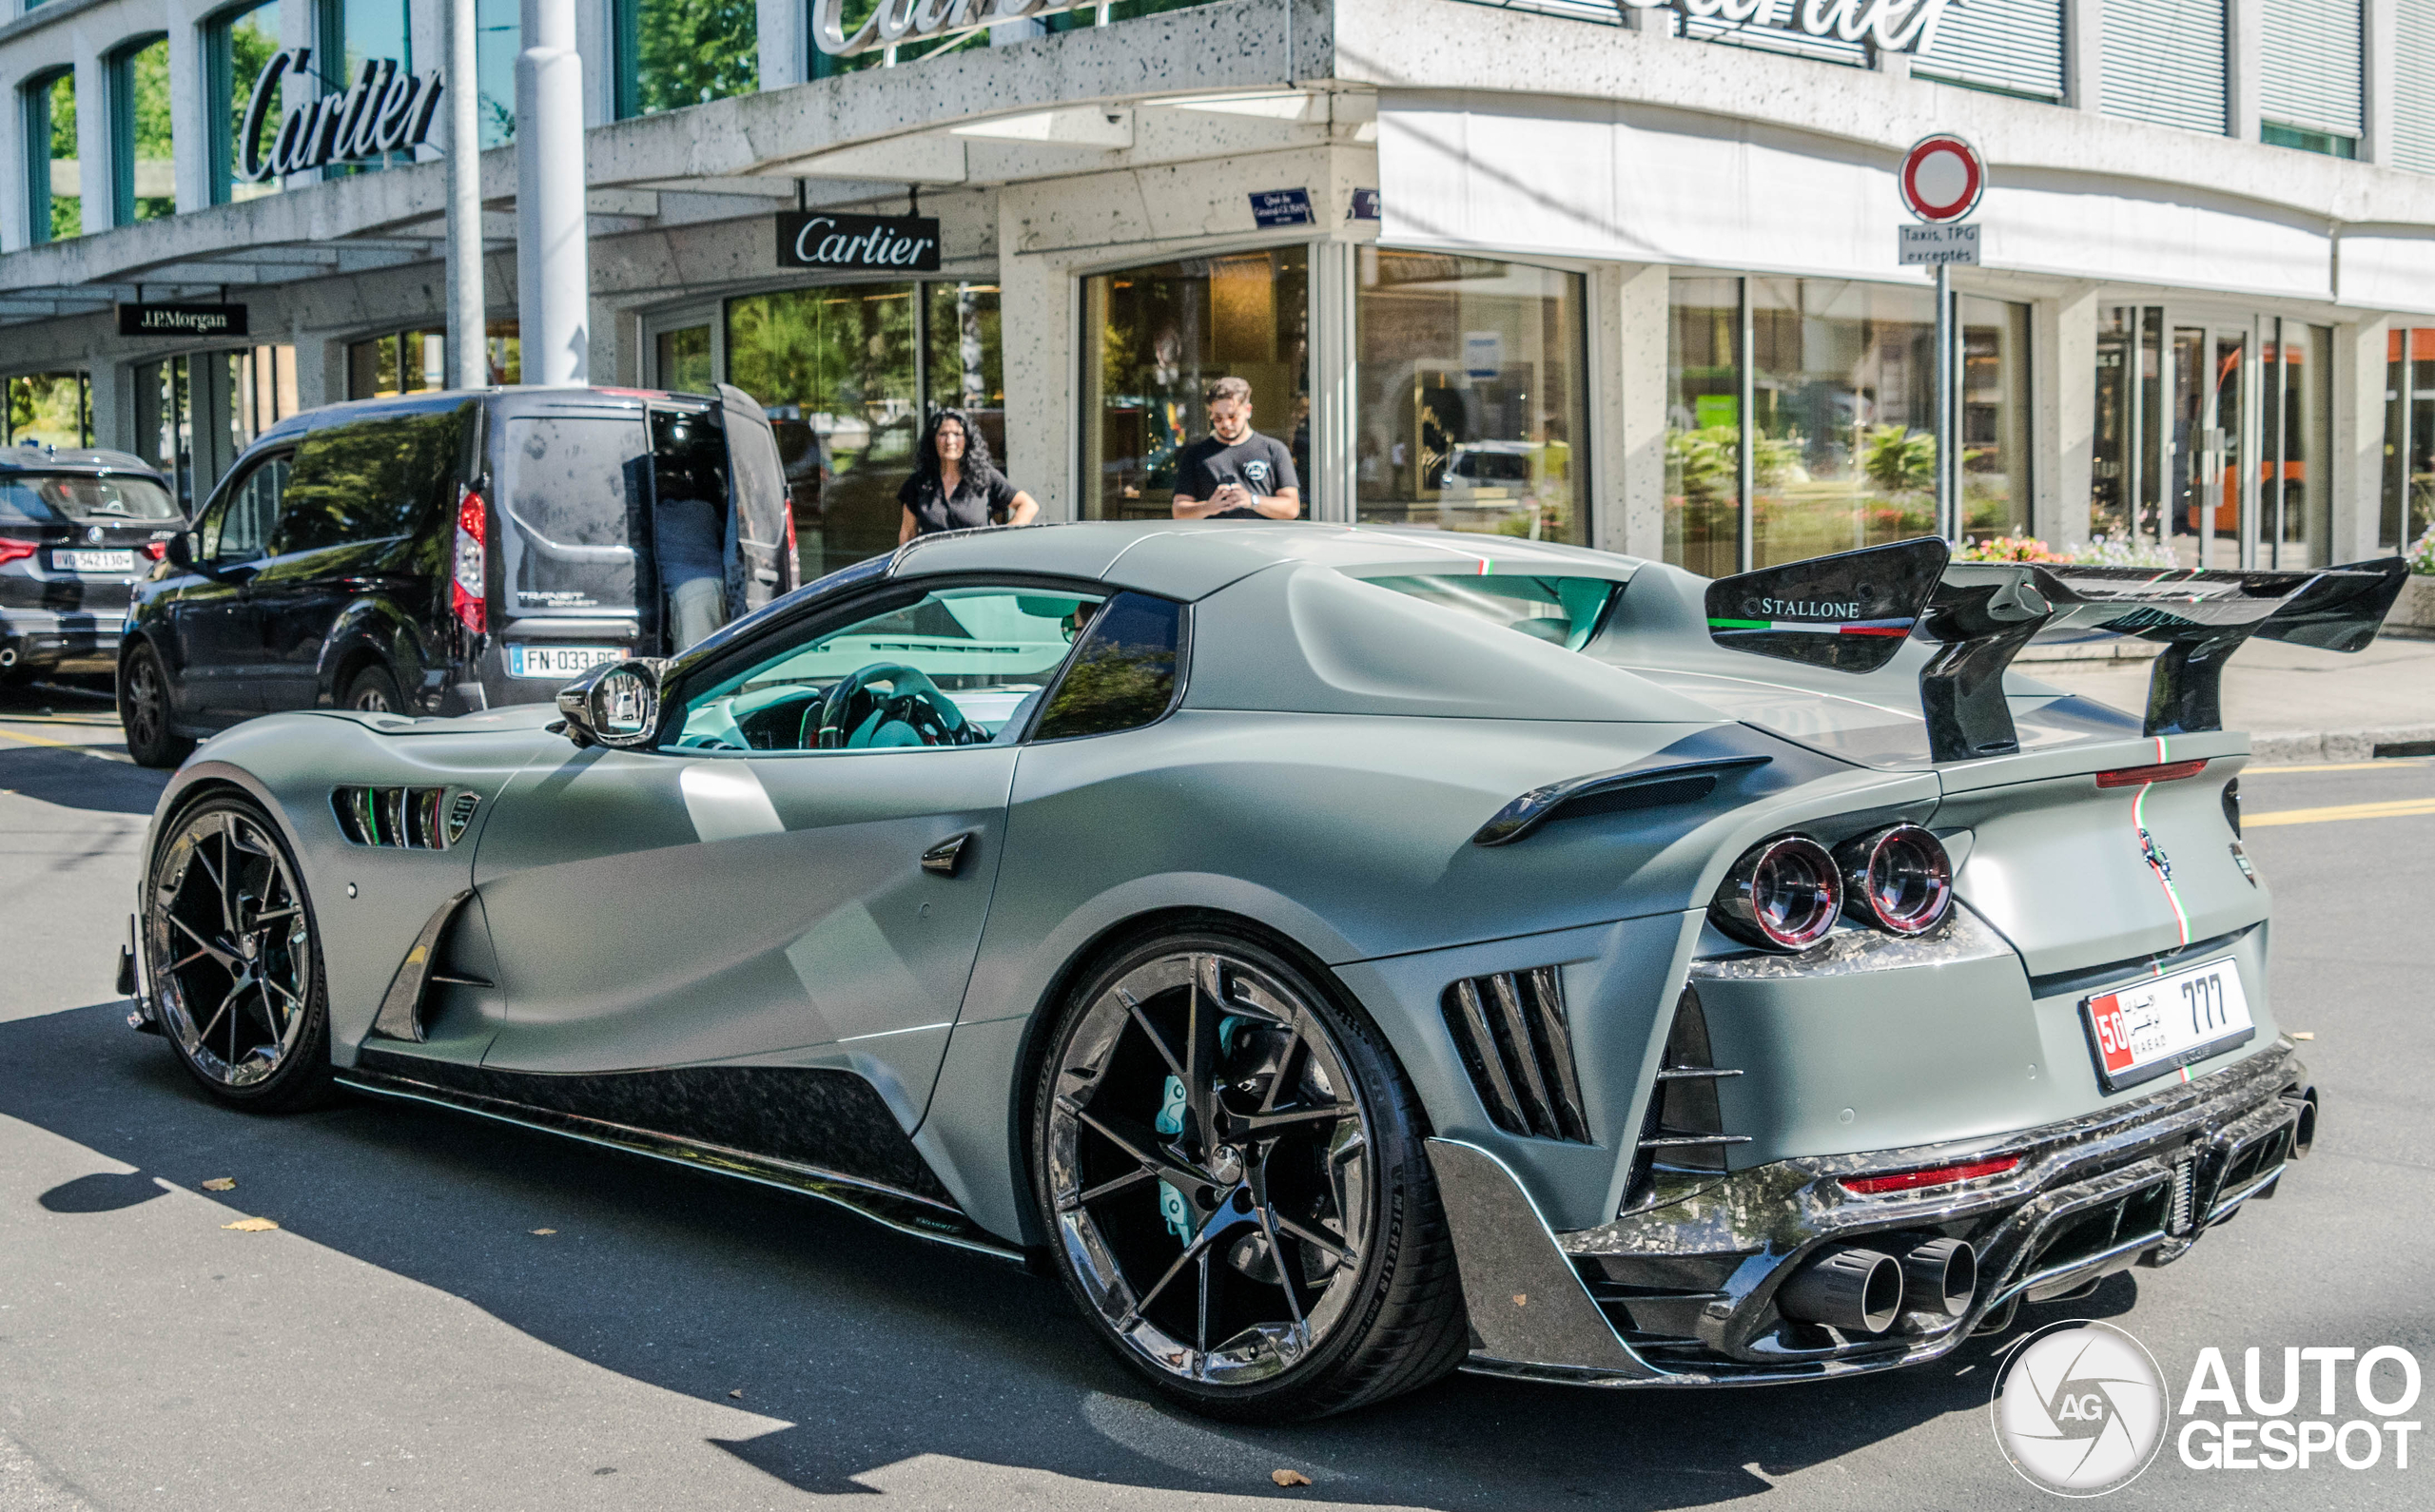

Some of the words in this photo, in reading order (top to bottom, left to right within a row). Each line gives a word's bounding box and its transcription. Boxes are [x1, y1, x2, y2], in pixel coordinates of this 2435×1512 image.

[240, 48, 445, 182] Cartier
[795, 216, 934, 265] Cartier
[1904, 228, 1942, 242] Taxis,
[1948, 227, 1975, 241] TPG
[1907, 249, 1972, 263] exceptés
[141, 310, 227, 333] J.P.Morgan
[516, 591, 585, 601] TRANSIT
[1762, 597, 1860, 618] STALLONE
[2181, 973, 2227, 1034] 777
[2096, 1012, 2128, 1055] 50
[1379, 1193, 1404, 1293] MICHELIN
